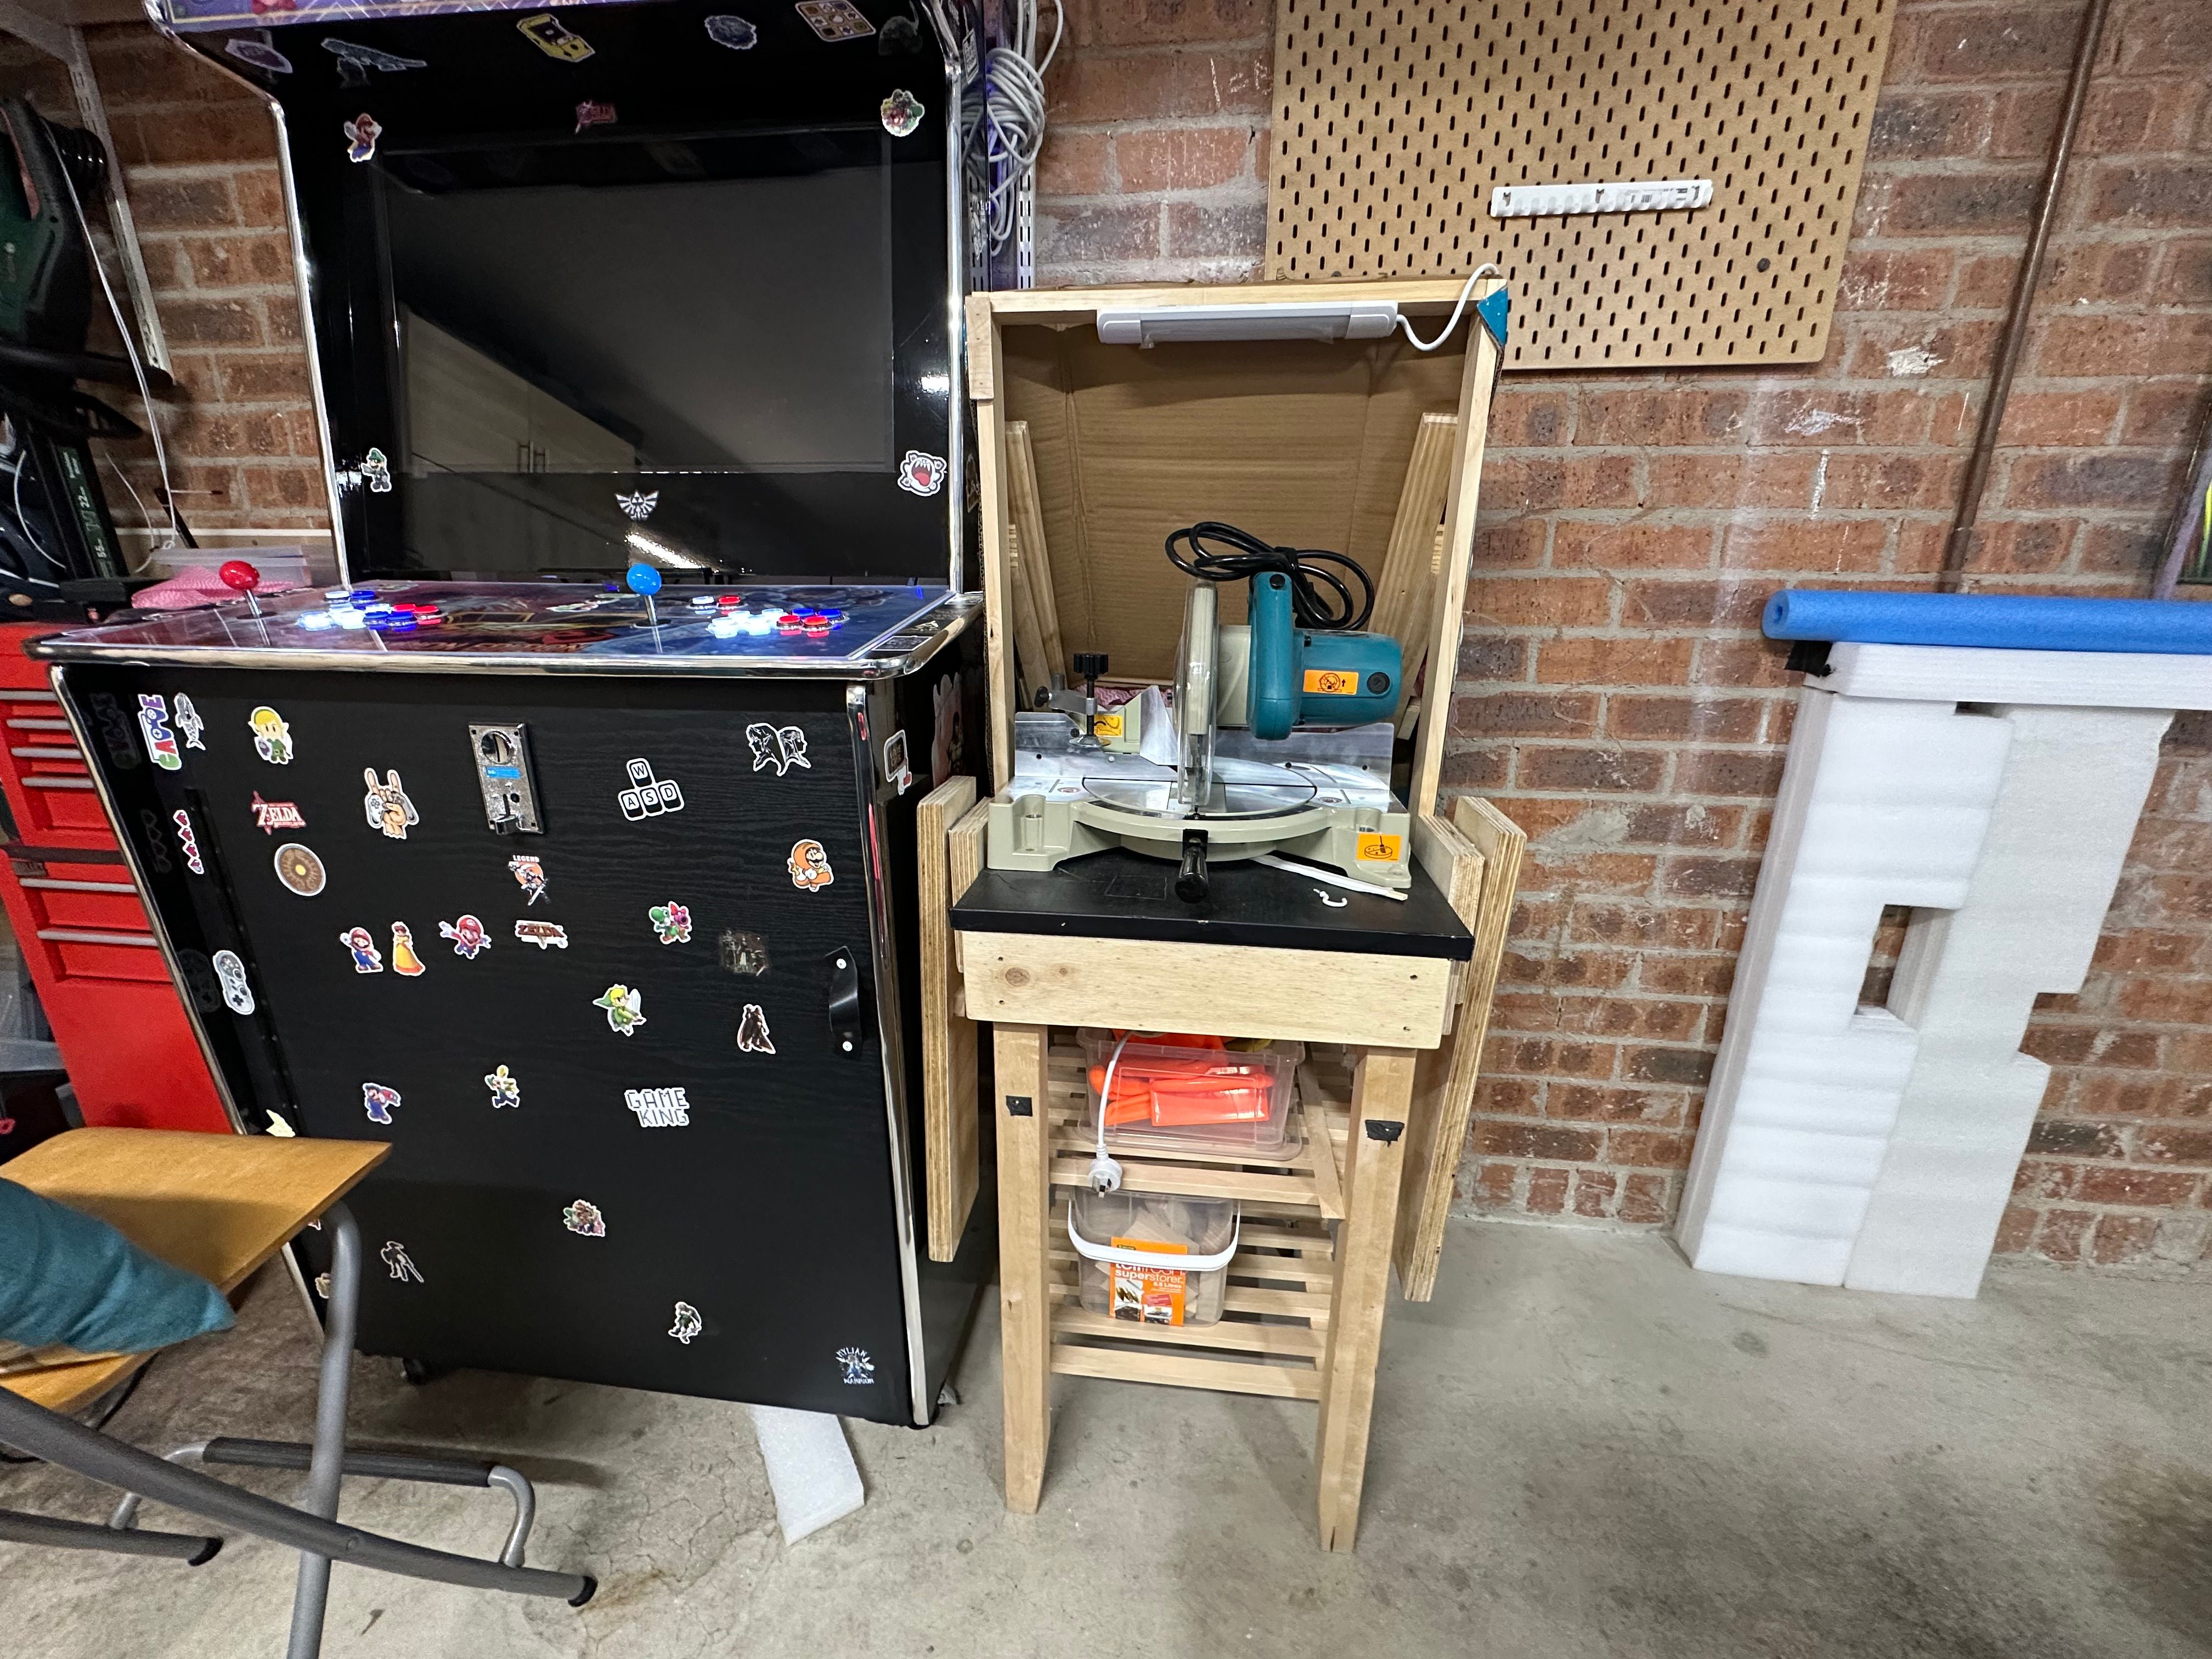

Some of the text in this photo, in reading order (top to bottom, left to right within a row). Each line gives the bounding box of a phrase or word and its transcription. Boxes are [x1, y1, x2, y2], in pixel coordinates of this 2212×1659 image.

[633, 765, 645, 776] W
[253, 804, 303, 825] ZELDA
[513, 855, 540, 863] LEGEND
[517, 924, 565, 938] ZELDA
[627, 1090, 687, 1109] GAME
[639, 1109, 687, 1125] KING
[836, 1347, 868, 1357] HYLIAN
